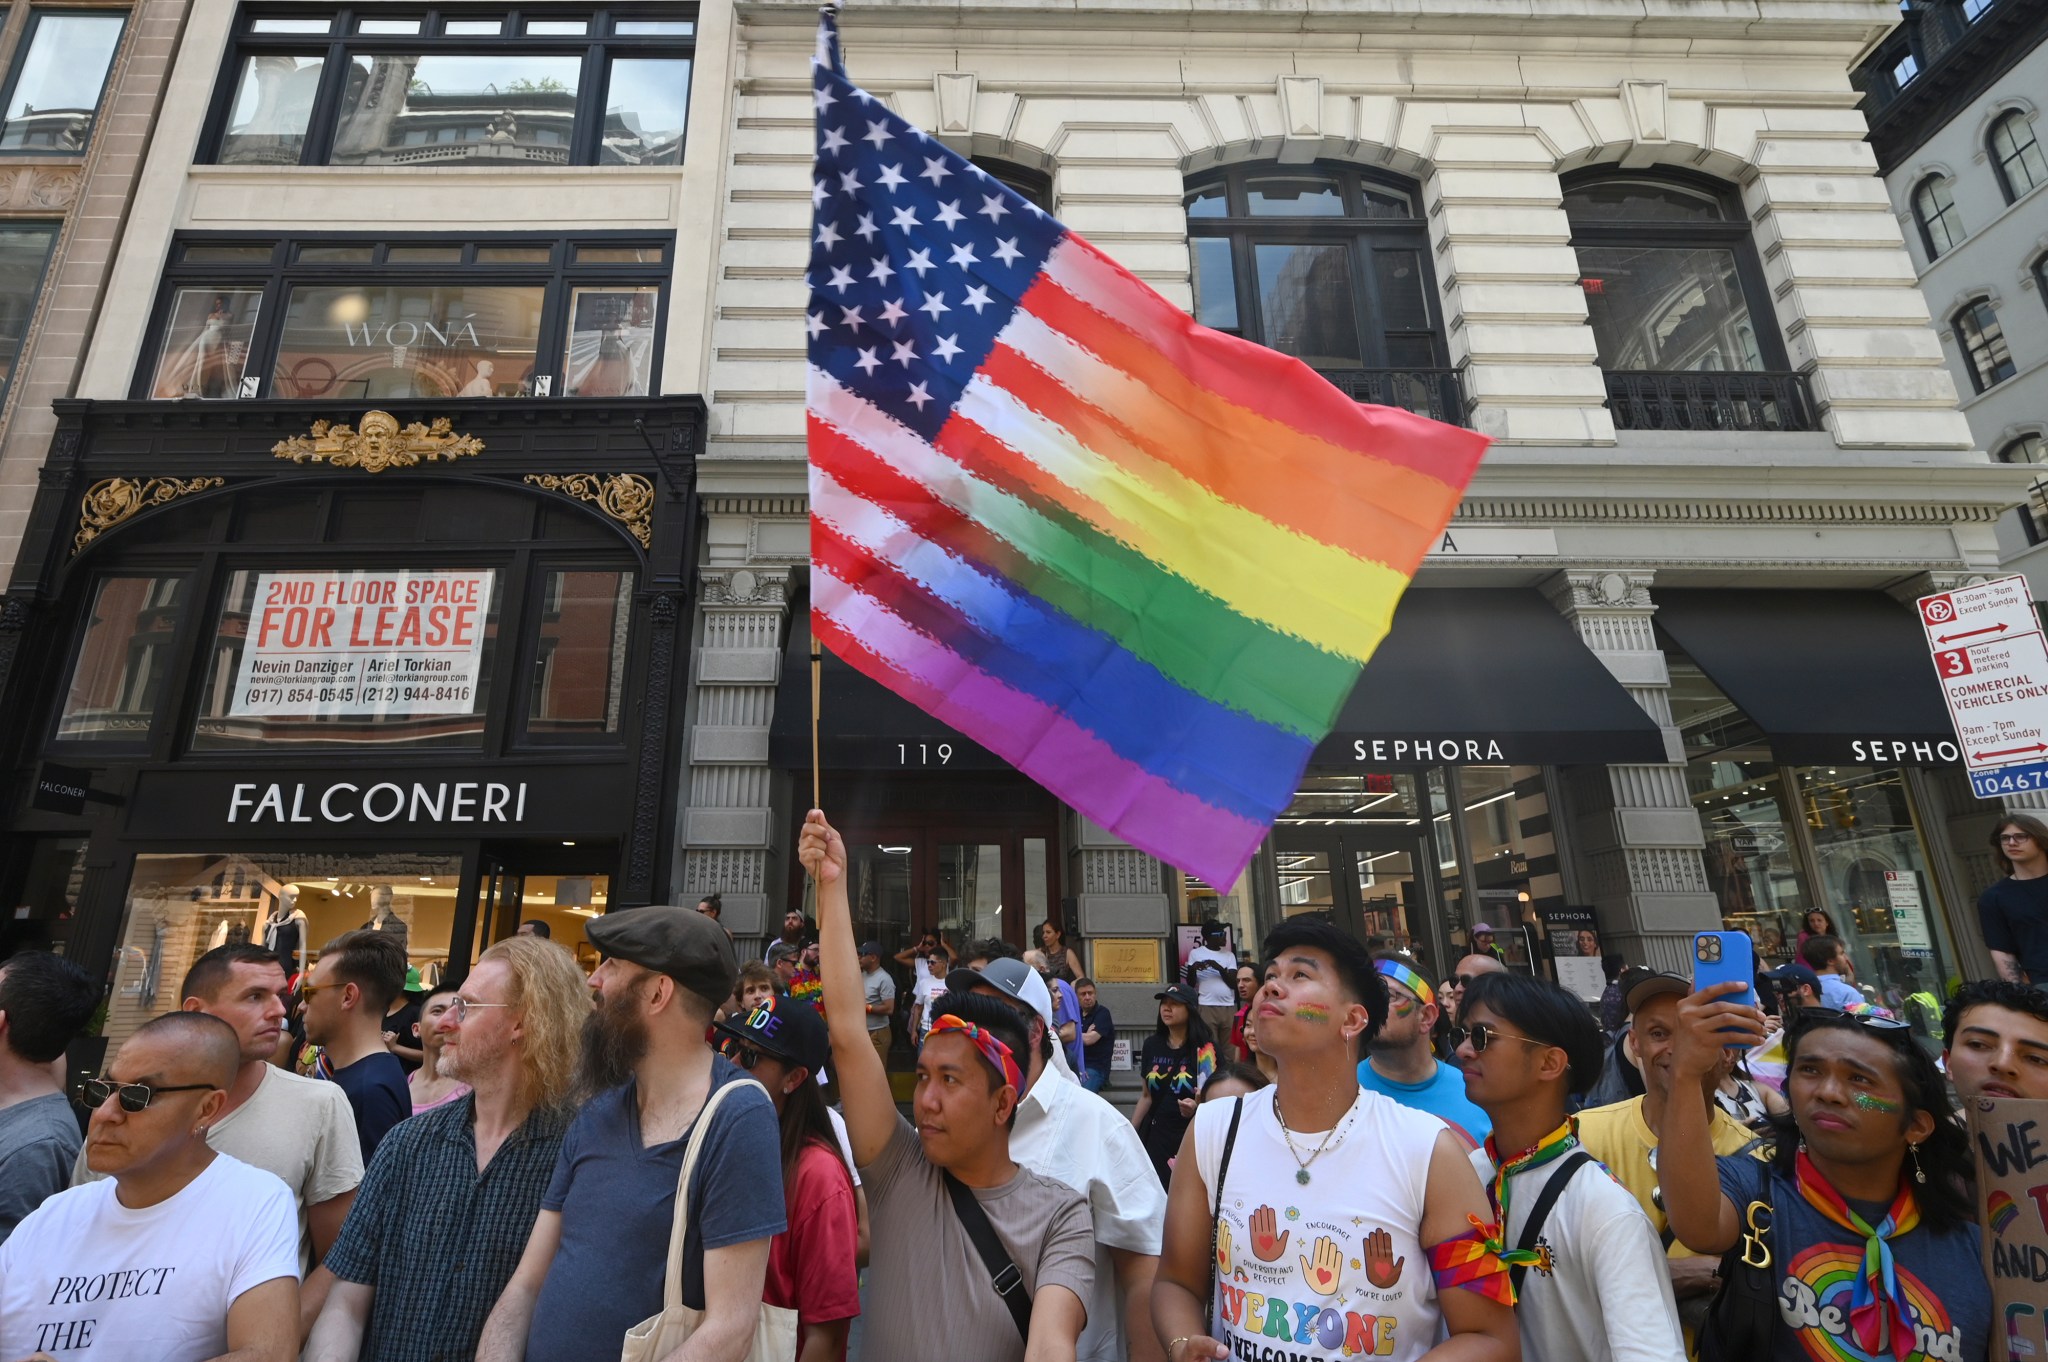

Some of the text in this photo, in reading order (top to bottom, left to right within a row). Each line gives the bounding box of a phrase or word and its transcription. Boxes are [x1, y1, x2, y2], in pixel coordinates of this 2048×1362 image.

[344, 313, 480, 347] WONÁ
[266, 580, 480, 605] 2ND FLOOR SPACE
[1956, 591, 1987, 605] 8:30am
[1994, 585, 2014, 598] 9am
[1958, 596, 2019, 615] Except Sunday
[257, 606, 477, 648] FOR LEASE
[1970, 646, 1990, 656] hour
[1973, 650, 2010, 664] metered
[252, 659, 354, 676] Nevin Danziger
[368, 659, 451, 672] Ariel Torkian
[1943, 651, 1965, 675] 3
[1976, 661, 2009, 674] parking
[250, 675, 355, 686] nevin@torkiangroup.com
[366, 674, 468, 684] ariel@torkiangroup.com
[1950, 674, 2033, 698] COMMERCIAL
[245, 688, 354, 705] (917) 854-0545
[362, 687, 470, 704] (212) 944-8416
[1954, 684, 2048, 710] VEHICLES ONLY
[1962, 724, 1985, 735] 9am
[1993, 720, 2016, 733] 7pm
[1965, 728, 2041, 747] Except Sunday
[898, 744, 953, 765] 119
[1354, 740, 1504, 761] SEPHORA
[40, 781, 86, 798] FALCONERI
[227, 782, 527, 823] FALCONERI
[1978, 1120, 2048, 1177] WE
[1305, 1221, 1351, 1242] ENCOURAGE
[1243, 1259, 1294, 1274] DIVERSITY AND
[1992, 1236, 2048, 1283] AND
[48, 1267, 175, 1305] PROTECT
[1253, 1273, 1286, 1285] RESPECT
[1355, 1286, 1403, 1301] YOU'RE LOVED
[1778, 1276, 1847, 1335] Be
[34, 1319, 97, 1352] THE
[1233, 1335, 1325, 1362] WELCO
